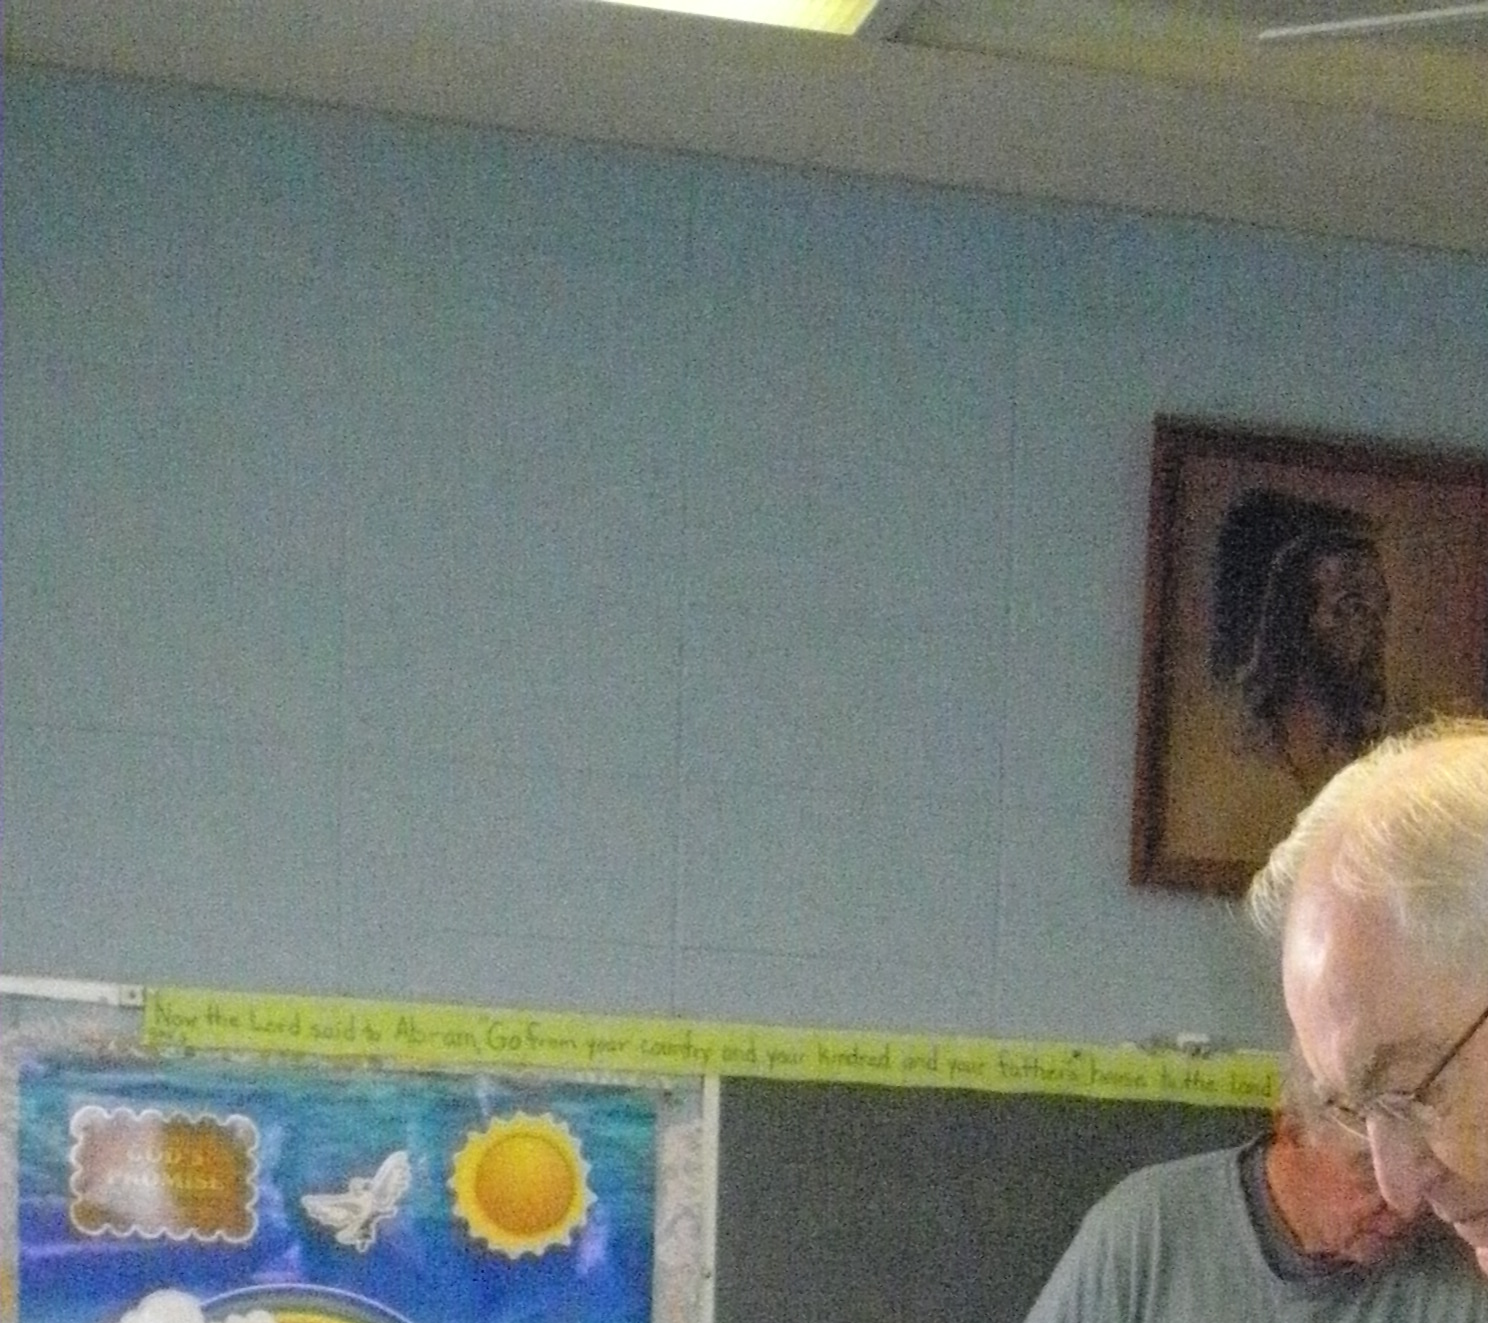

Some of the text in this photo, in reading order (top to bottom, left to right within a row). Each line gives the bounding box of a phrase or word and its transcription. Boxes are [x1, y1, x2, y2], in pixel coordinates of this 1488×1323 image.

[155, 1003, 197, 1027] Now
[205, 1003, 238, 1029] the
[311, 1014, 357, 1042] said
[486, 1022, 522, 1053] Go
[588, 1036, 626, 1064] your
[640, 1030, 712, 1065] country
[720, 1036, 757, 1065] and
[766, 1045, 805, 1072] your
[818, 1040, 892, 1070] kindred
[904, 1043, 939, 1073] and
[948, 1056, 985, 1080] your
[1183, 1067, 1217, 1092] the
